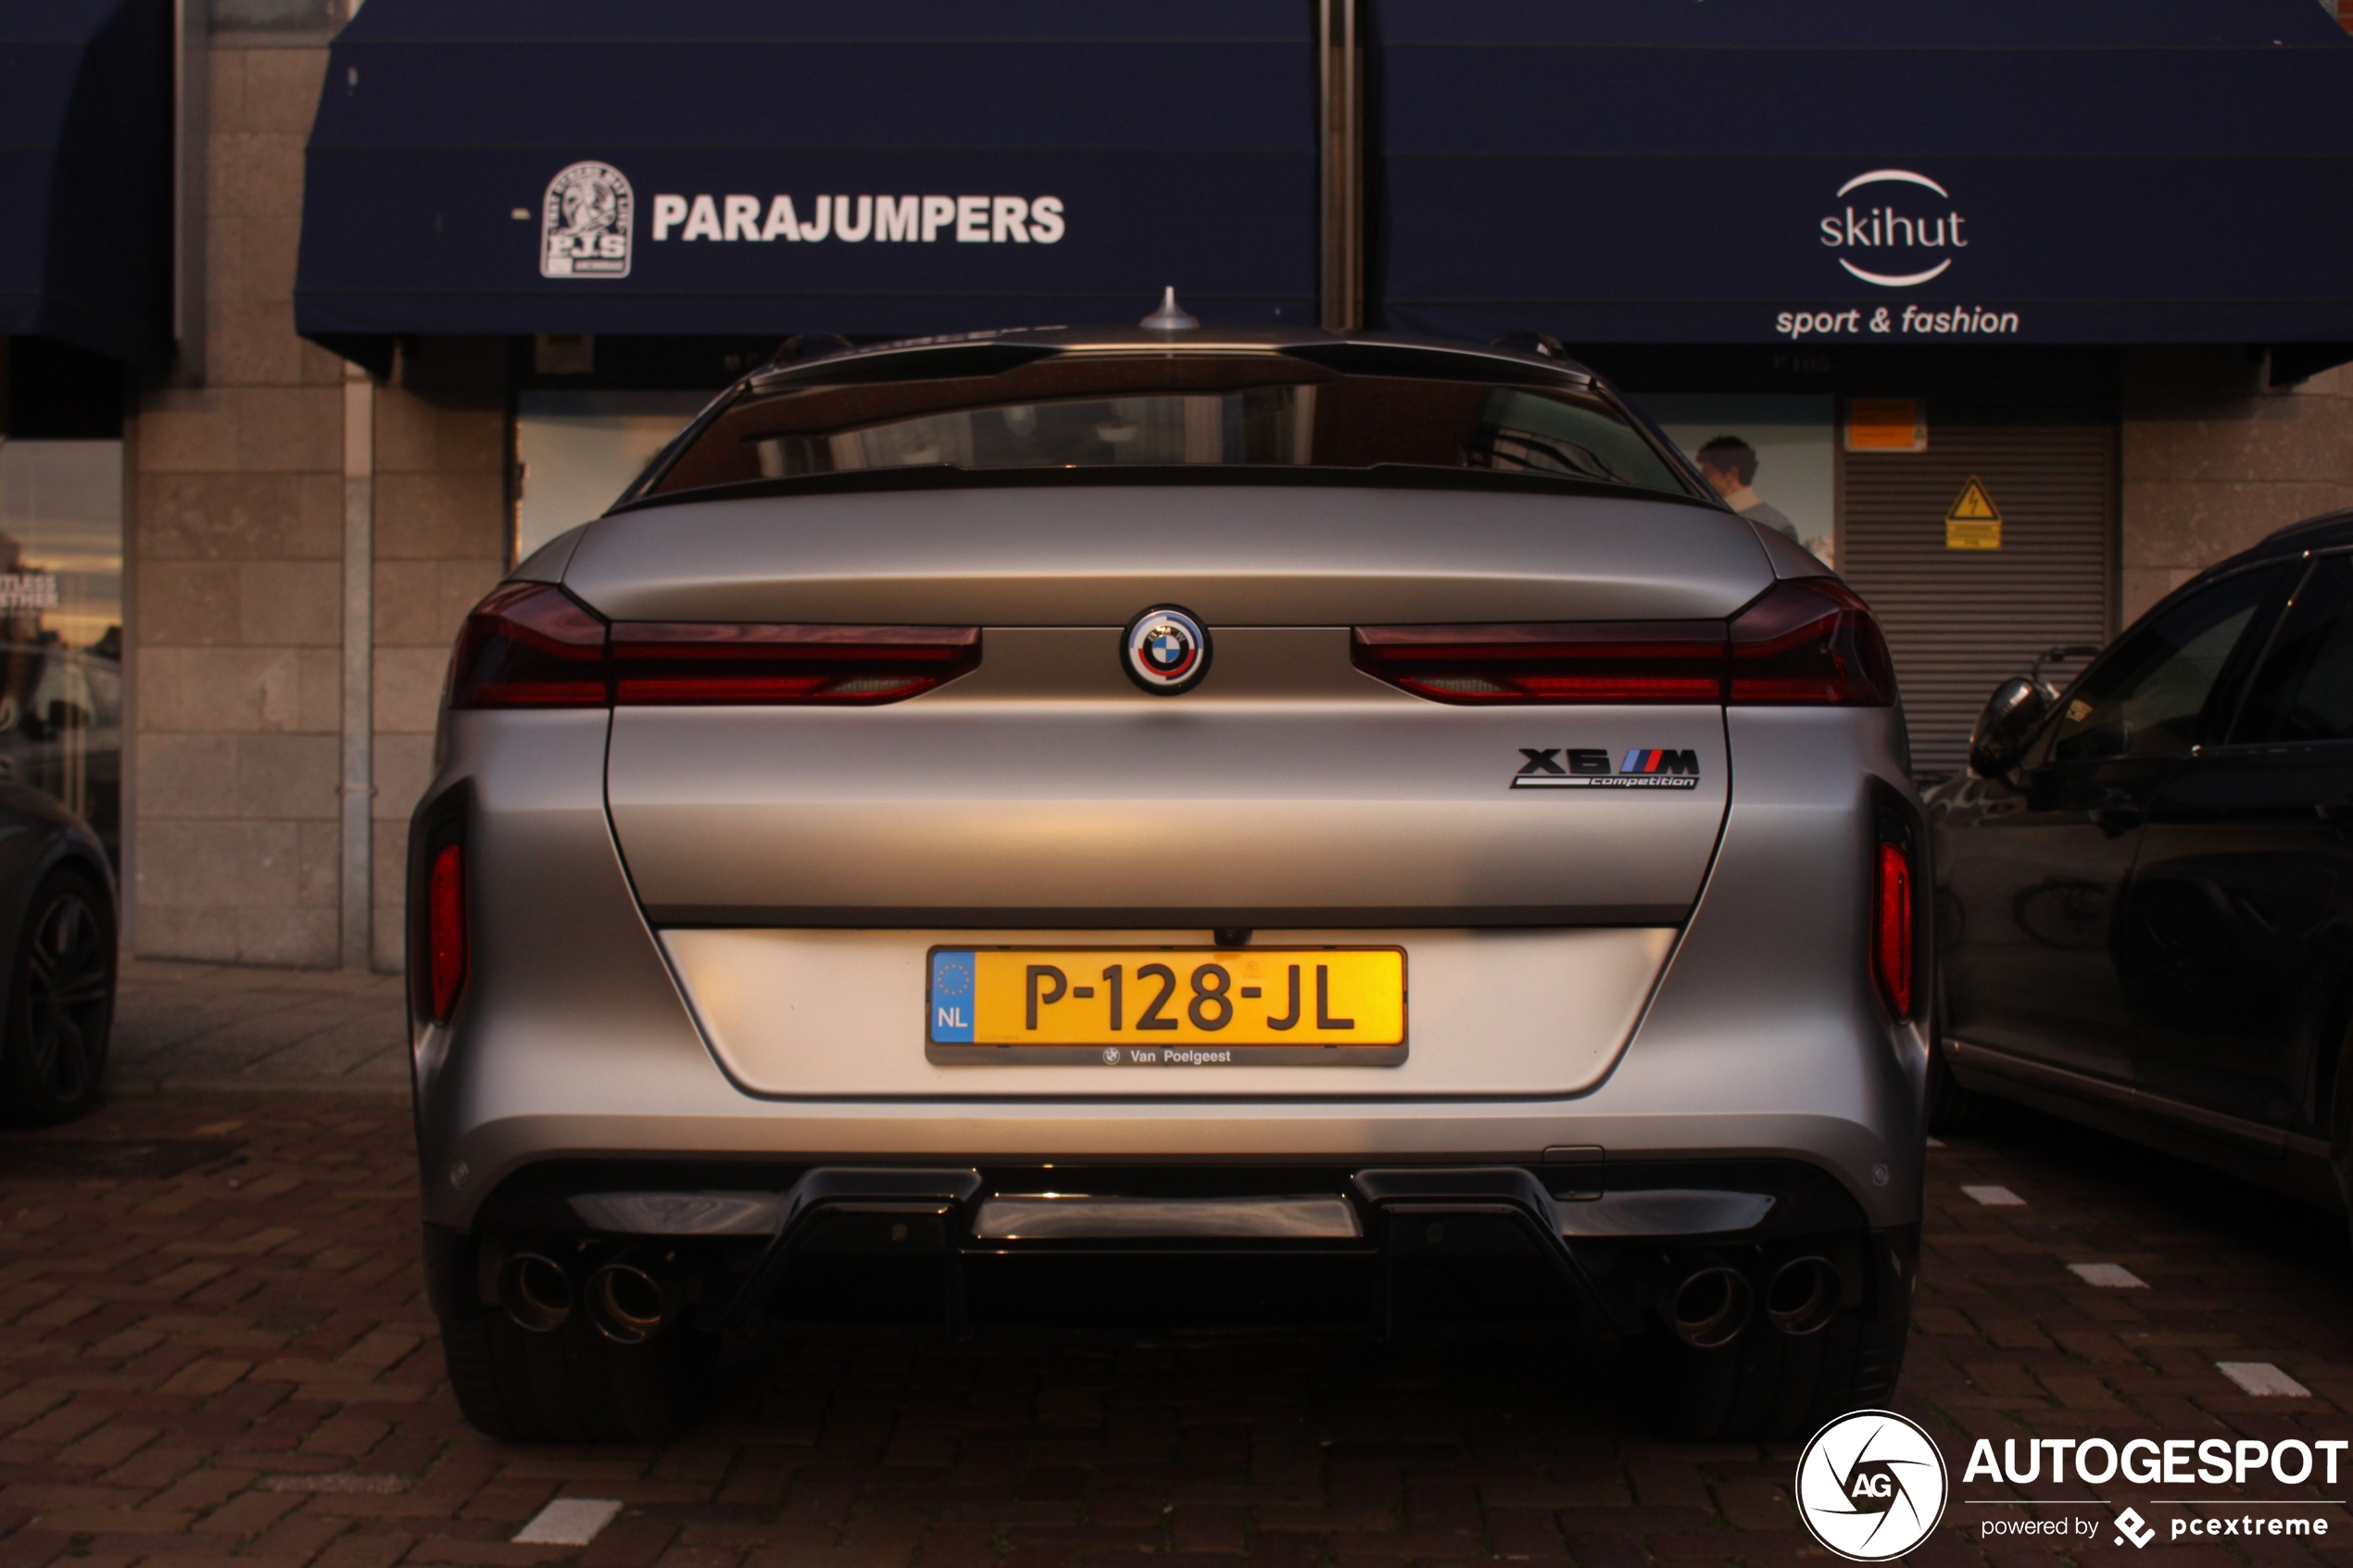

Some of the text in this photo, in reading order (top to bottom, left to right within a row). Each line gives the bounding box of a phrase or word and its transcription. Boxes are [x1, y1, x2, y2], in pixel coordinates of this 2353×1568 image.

[652, 194, 1065, 244] PARAJUMPERS
[1820, 207, 1968, 247] skihut
[1776, 305, 2020, 340] sport & fashion
[1148, 626, 1186, 642] BMW
[1517, 748, 1700, 775] X6 M
[1591, 776, 1695, 787] competition
[1026, 962, 1355, 1032] P-128-JL
[938, 1008, 968, 1028] NL
[1130, 1049, 1231, 1065] Van Poelgeest
